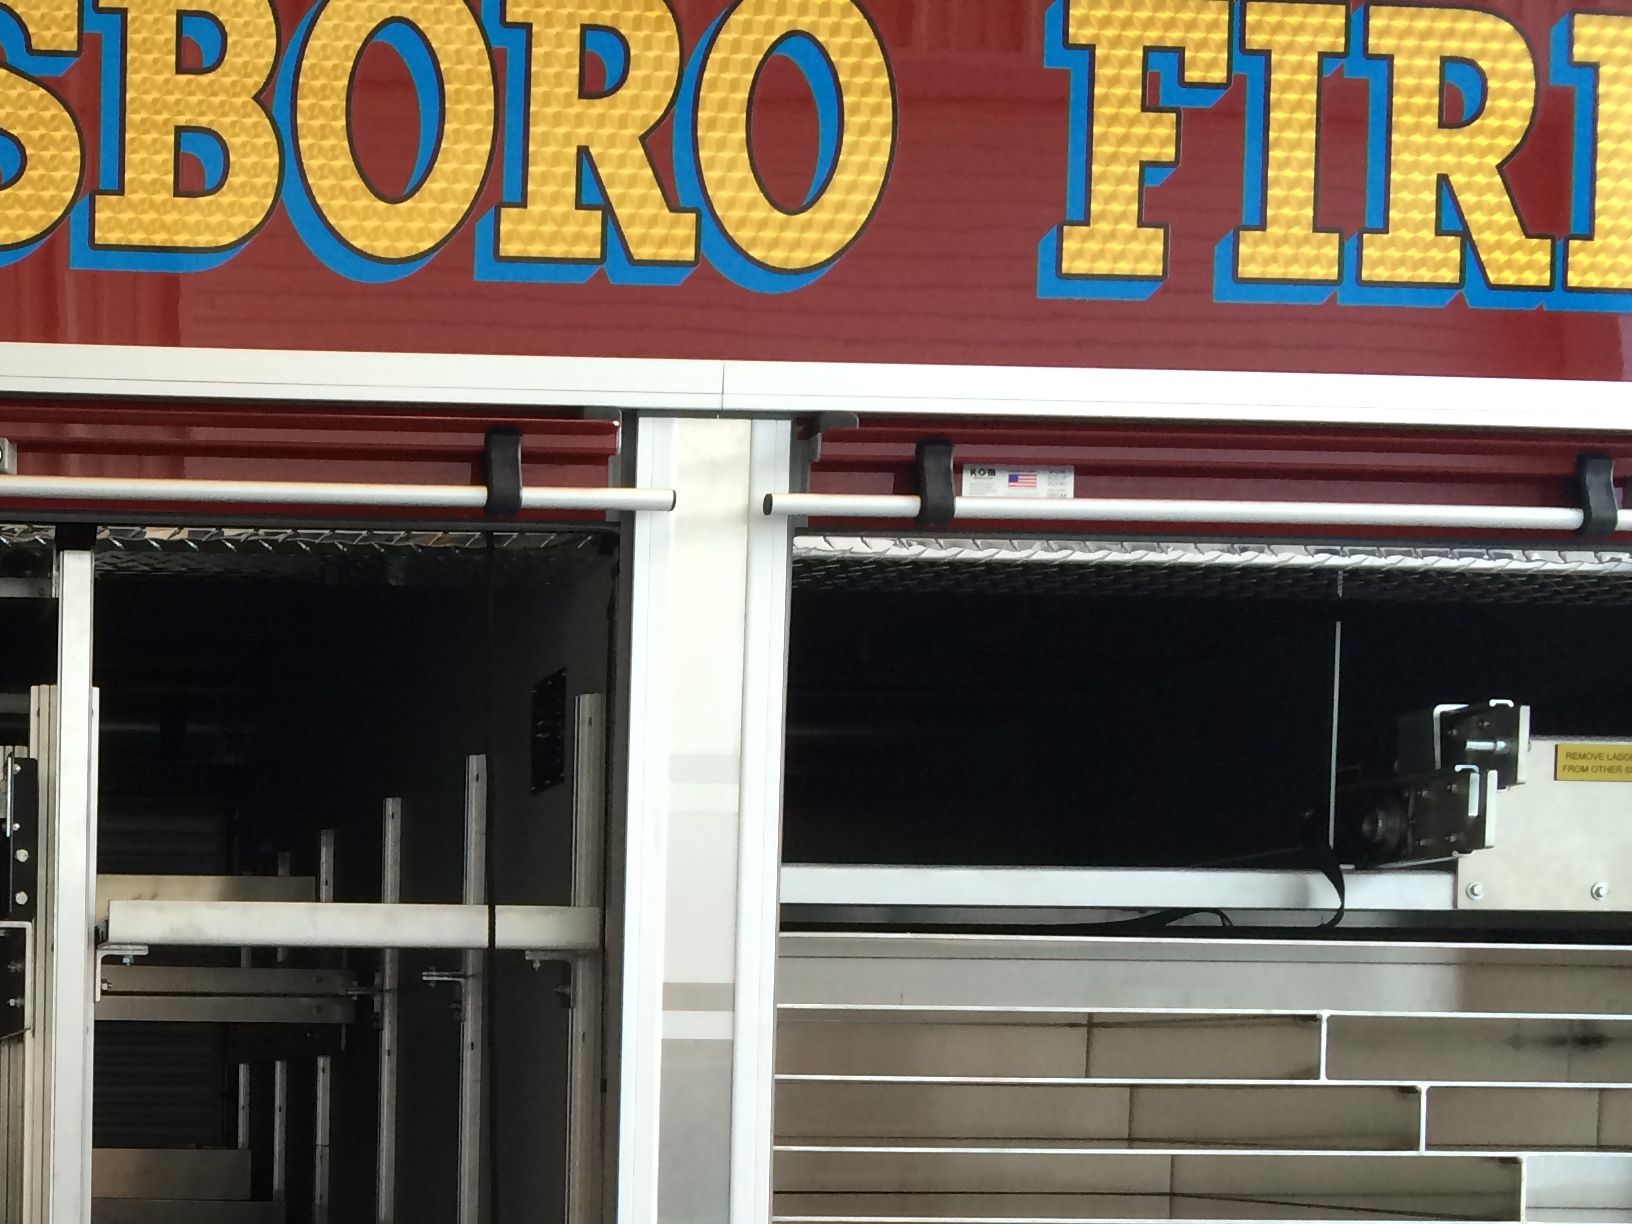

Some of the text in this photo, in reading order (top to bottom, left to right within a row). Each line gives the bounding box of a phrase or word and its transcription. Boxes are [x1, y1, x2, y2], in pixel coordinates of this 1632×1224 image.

[1566, 751, 1604, 760] REMOVE
[1562, 764, 1588, 773] FROM
[1591, 765, 1622, 773] OTHER
